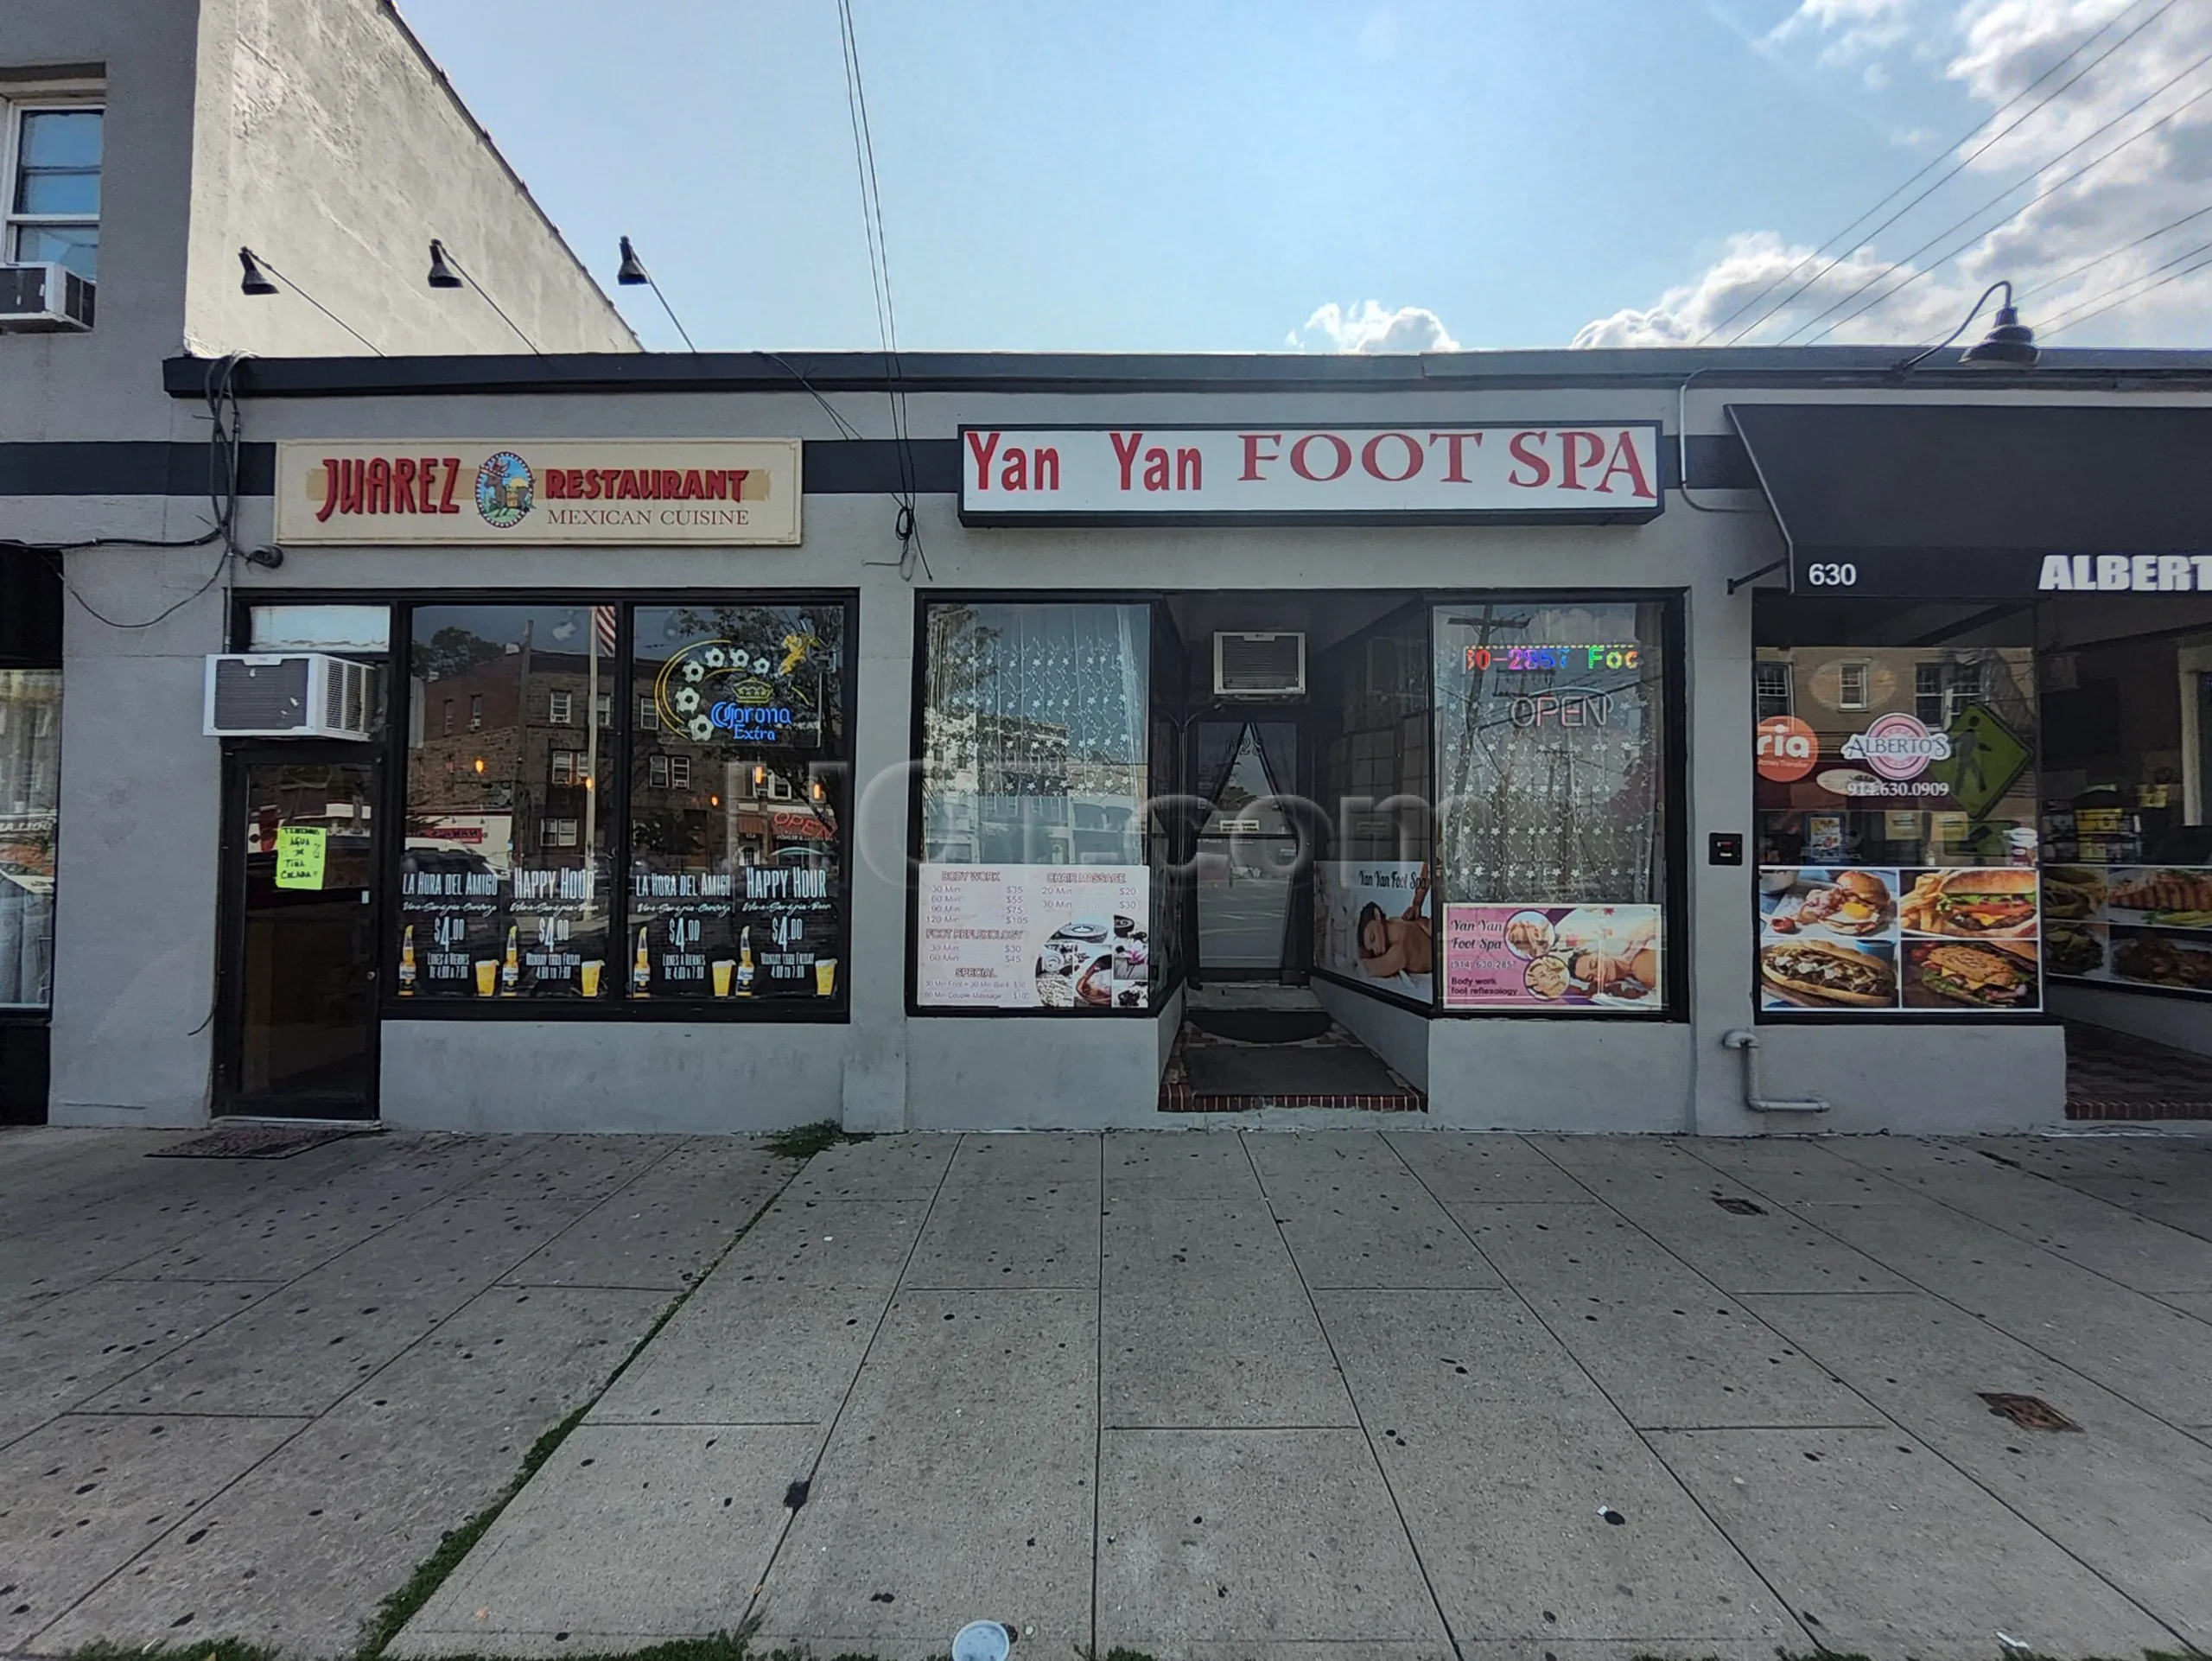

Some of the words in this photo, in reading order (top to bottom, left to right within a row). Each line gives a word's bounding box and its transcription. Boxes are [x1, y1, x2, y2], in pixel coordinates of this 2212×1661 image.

[967, 432, 1059, 492] Yan
[1110, 432, 1202, 492] Yan
[1237, 433, 1483, 482] FOOT
[1508, 430, 1656, 499] SPA
[315, 457, 461, 523] JUAREZ
[544, 468, 750, 503] RESTAURANT
[548, 510, 652, 525] MEXICAN
[661, 510, 750, 525] CUISINE
[1808, 563, 1857, 587] 630
[710, 701, 791, 729] Corona
[1512, 696, 1607, 727] OPEN
[734, 725, 776, 740] Extra
[1758, 724, 1809, 758] ria
[1845, 735, 1948, 758] ALBERTO'S
[774, 812, 838, 839] OPEN
[403, 873, 415, 895] LA
[418, 871, 442, 895] HORA
[445, 873, 463, 895] DEL
[465, 872, 498, 896] AMIGO
[514, 867, 556, 900] HAPPY
[561, 867, 595, 900] HOUR
[636, 875, 648, 896] LA
[652, 873, 677, 896] HORA
[679, 875, 698, 896] DEL
[701, 873, 731, 896] AMIGO
[746, 867, 789, 899] HAPPY
[793, 867, 827, 899] HOUR
[941, 871, 969, 881] BODY
[970, 871, 1001, 881] WORK
[1006, 885, 1023, 894] $35
[1041, 887, 1054, 895] 20
[1056, 887, 1072, 895] Min
[1119, 888, 1137, 896] $20
[1006, 895, 1023, 904] $55
[1119, 901, 1137, 909] $30
[1006, 906, 1024, 914] $75
[1006, 916, 1028, 925] $105
[1451, 919, 1475, 932] Yan
[1478, 919, 1502, 932] Yan
[434, 916, 465, 952] $4.00
[538, 917, 569, 953] $4.00
[669, 917, 700, 953] $4.00
[772, 916, 803, 952] $4.00
[925, 928, 952, 939] FOOT
[1004, 945, 1021, 953] $30
[1452, 937, 1476, 950] Foot
[1478, 938, 1502, 952] Spa
[1004, 954, 1021, 963] $45
[955, 968, 998, 977] SPECIAL
[1452, 977, 1473, 986] Body
[1452, 986, 1468, 995] foot
[1471, 986, 1518, 996] reflexology
